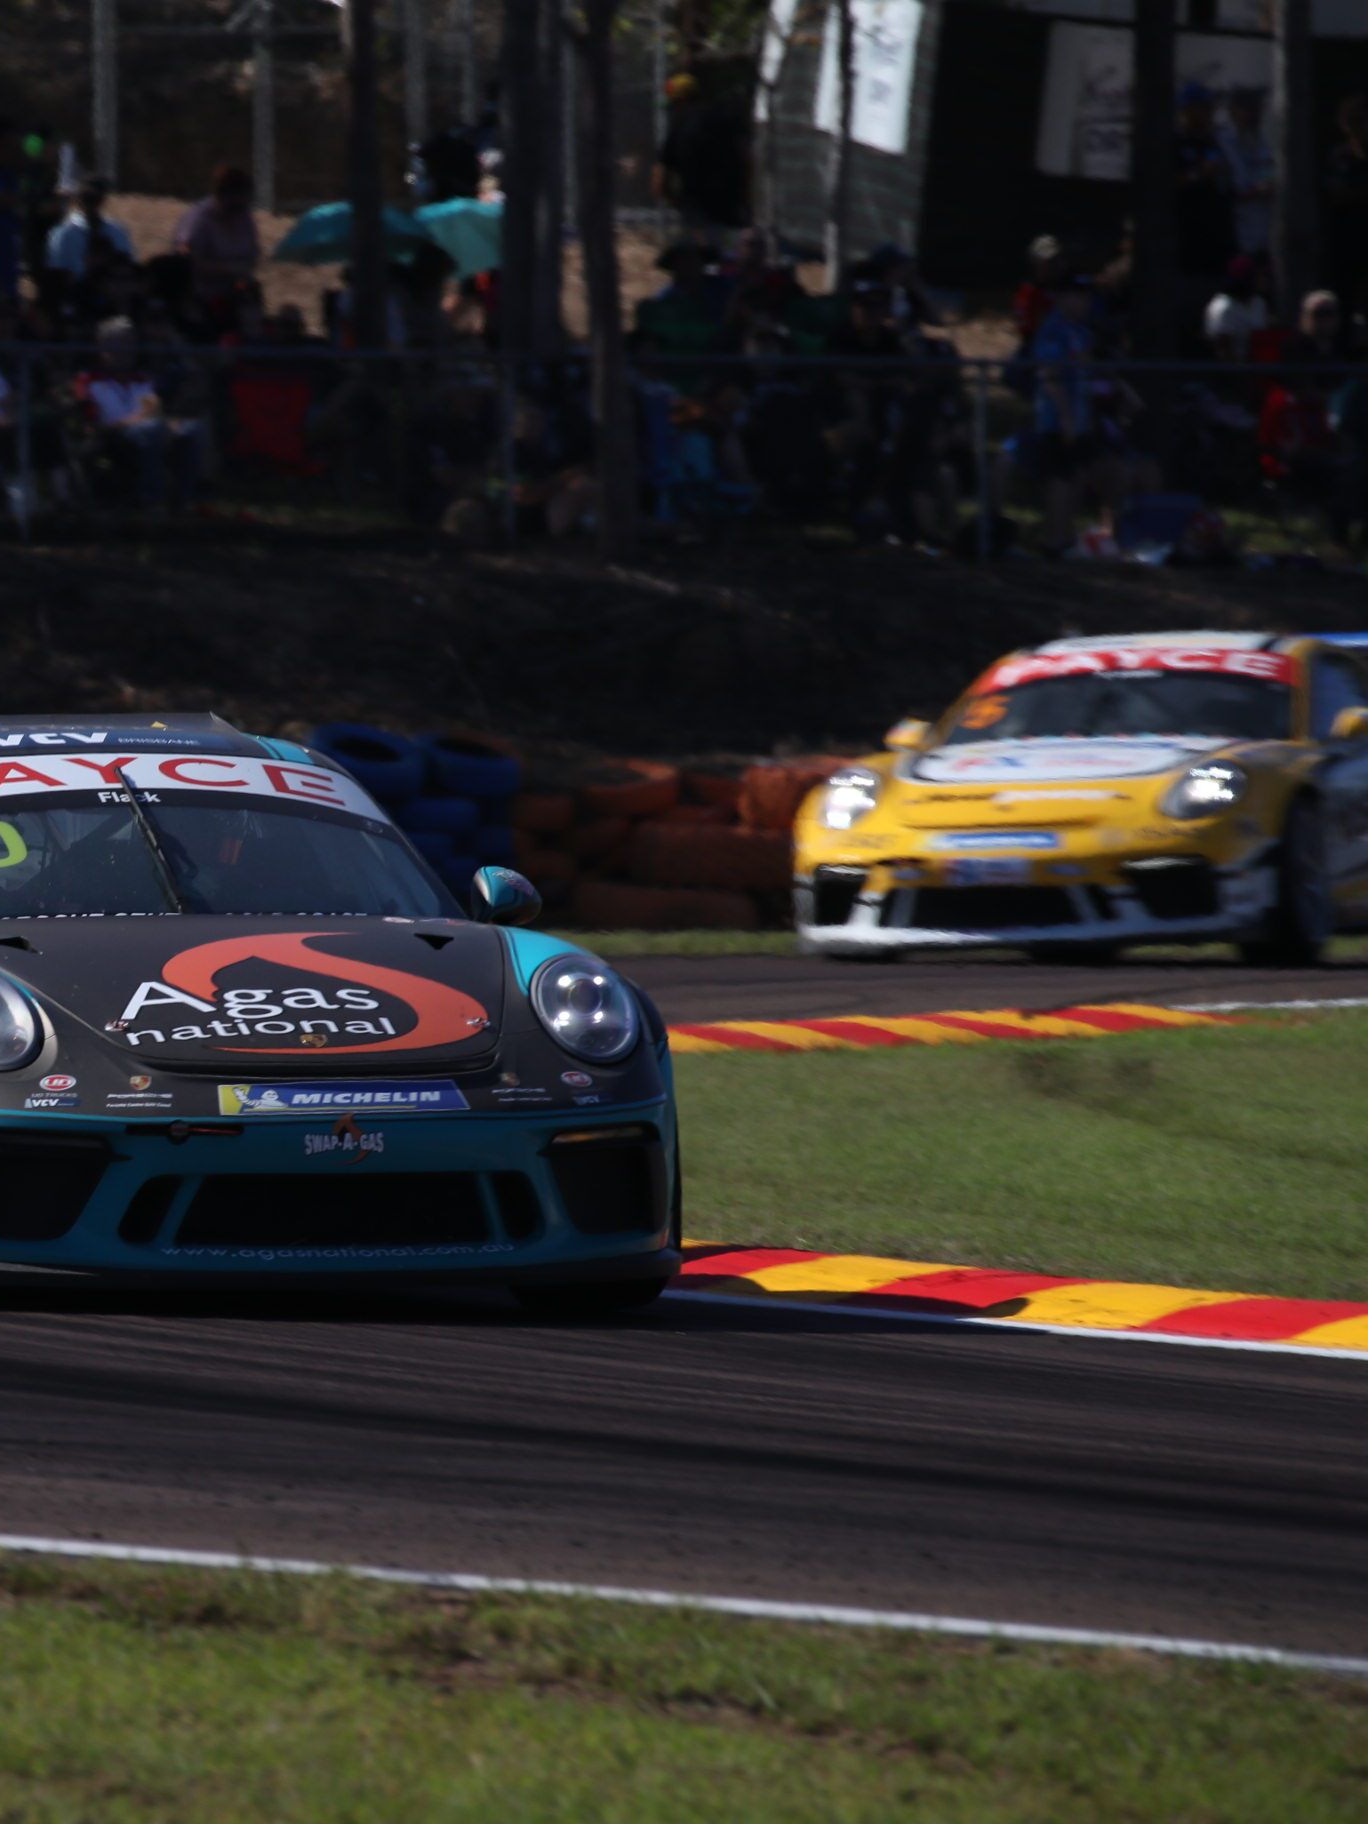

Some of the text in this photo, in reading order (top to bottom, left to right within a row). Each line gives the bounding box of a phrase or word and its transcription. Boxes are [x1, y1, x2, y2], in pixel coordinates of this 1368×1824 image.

[97, 790, 162, 803] Flack
[121, 980, 380, 1018] Agas
[126, 1016, 398, 1046] national
[292, 1089, 442, 1105] MICHELIN
